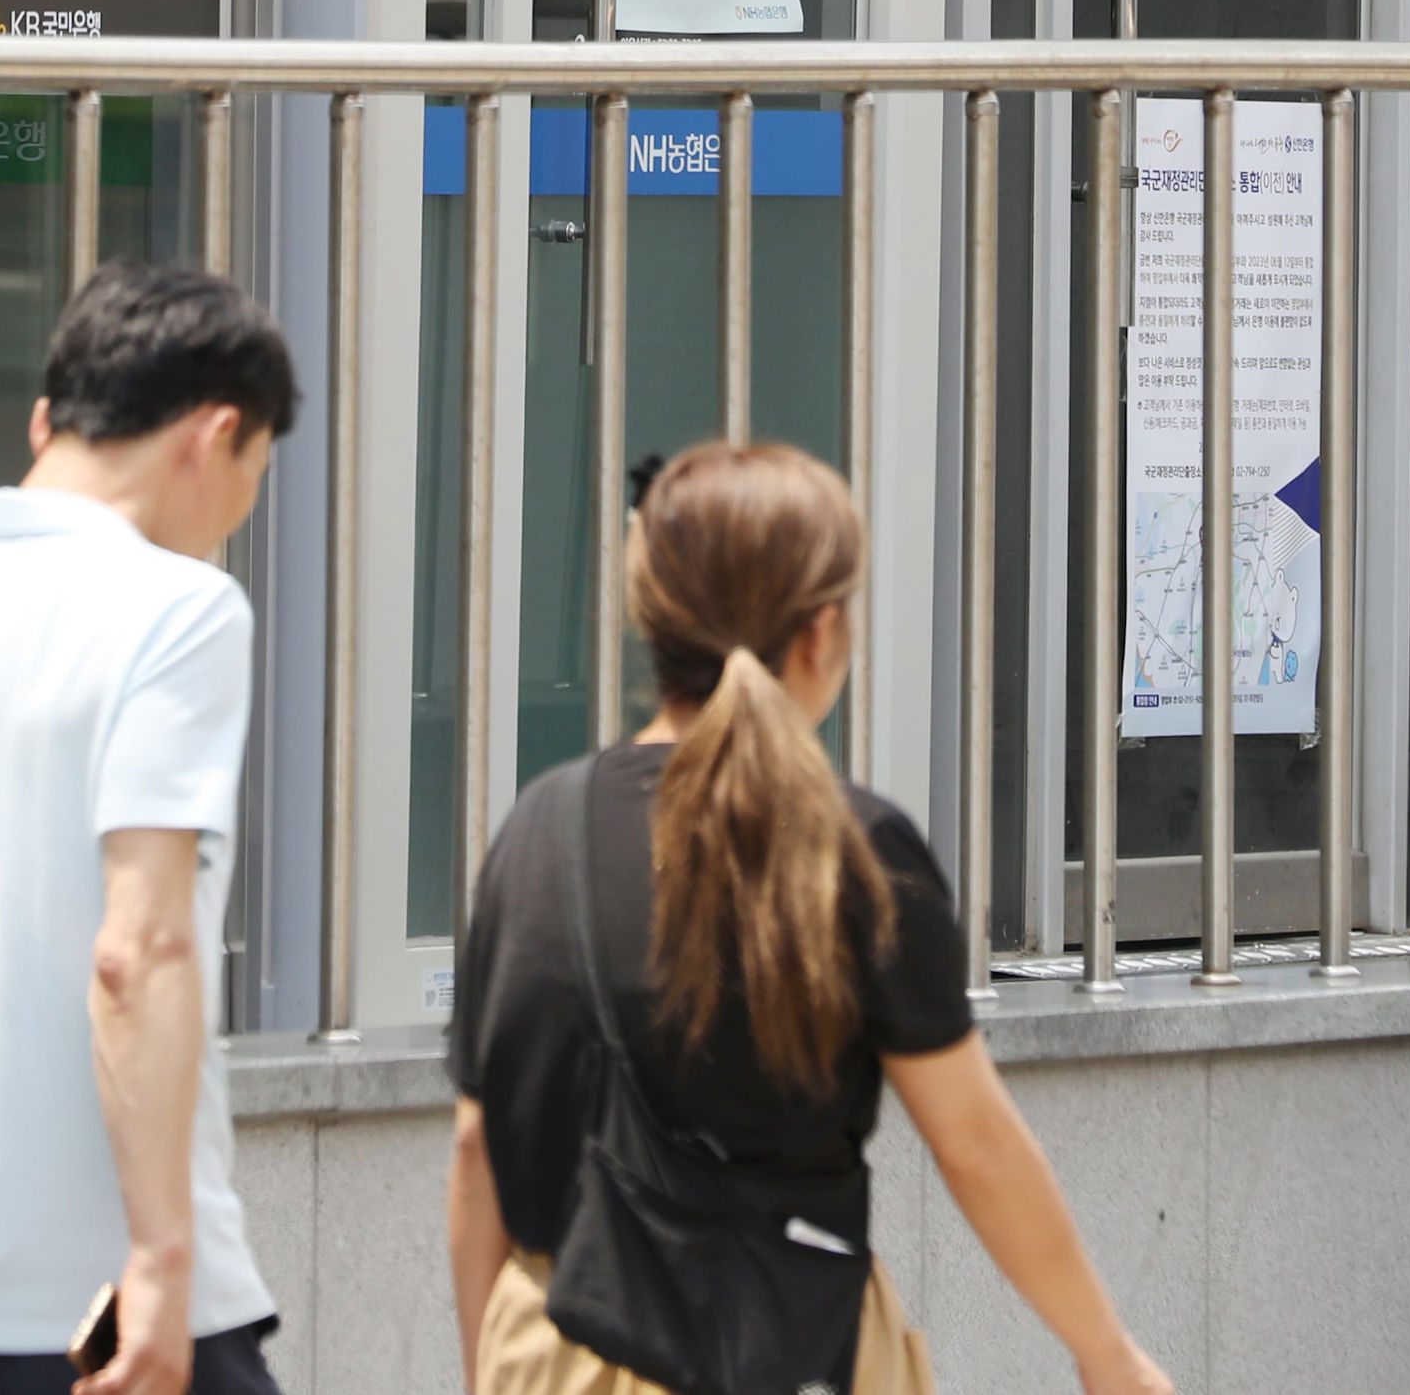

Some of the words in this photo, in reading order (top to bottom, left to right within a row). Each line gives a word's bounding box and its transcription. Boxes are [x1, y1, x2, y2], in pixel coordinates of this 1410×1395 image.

[629, 133, 721, 174] NH농협은
[1292, 136, 1315, 152] 신한은행
[1140, 168, 1237, 194] 국군재정관리단
[1239, 170, 1285, 195] 통합(이전)
[1286, 171, 1303, 194] 안내
